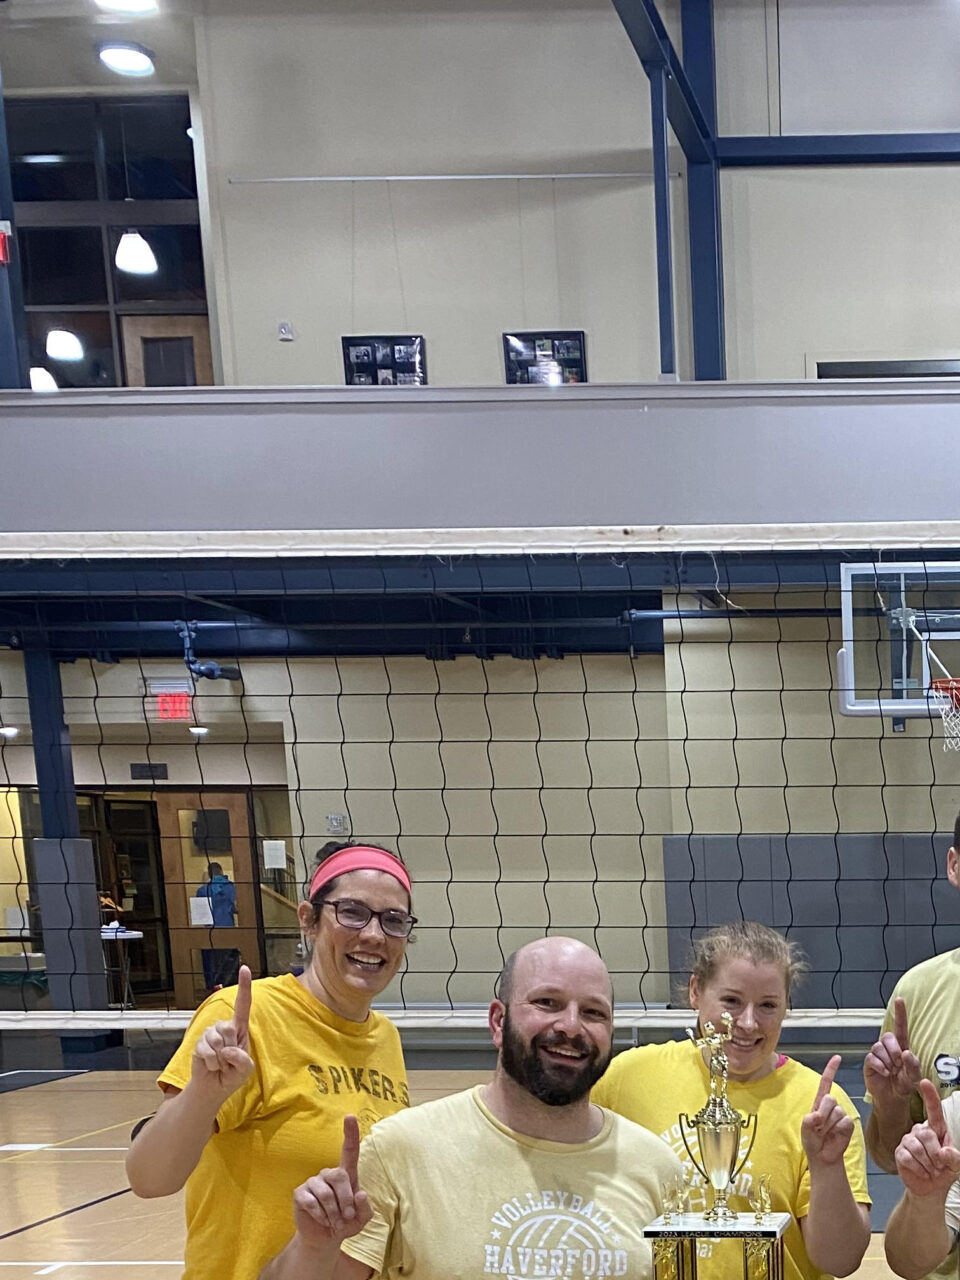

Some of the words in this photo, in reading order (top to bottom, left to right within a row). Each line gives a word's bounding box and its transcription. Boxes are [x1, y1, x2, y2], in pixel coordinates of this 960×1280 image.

[307, 1064, 411, 1108] SPIKERS
[490, 1189, 617, 1235] VOLLEYBALL
[484, 1244, 628, 1277] HAVERFORD
